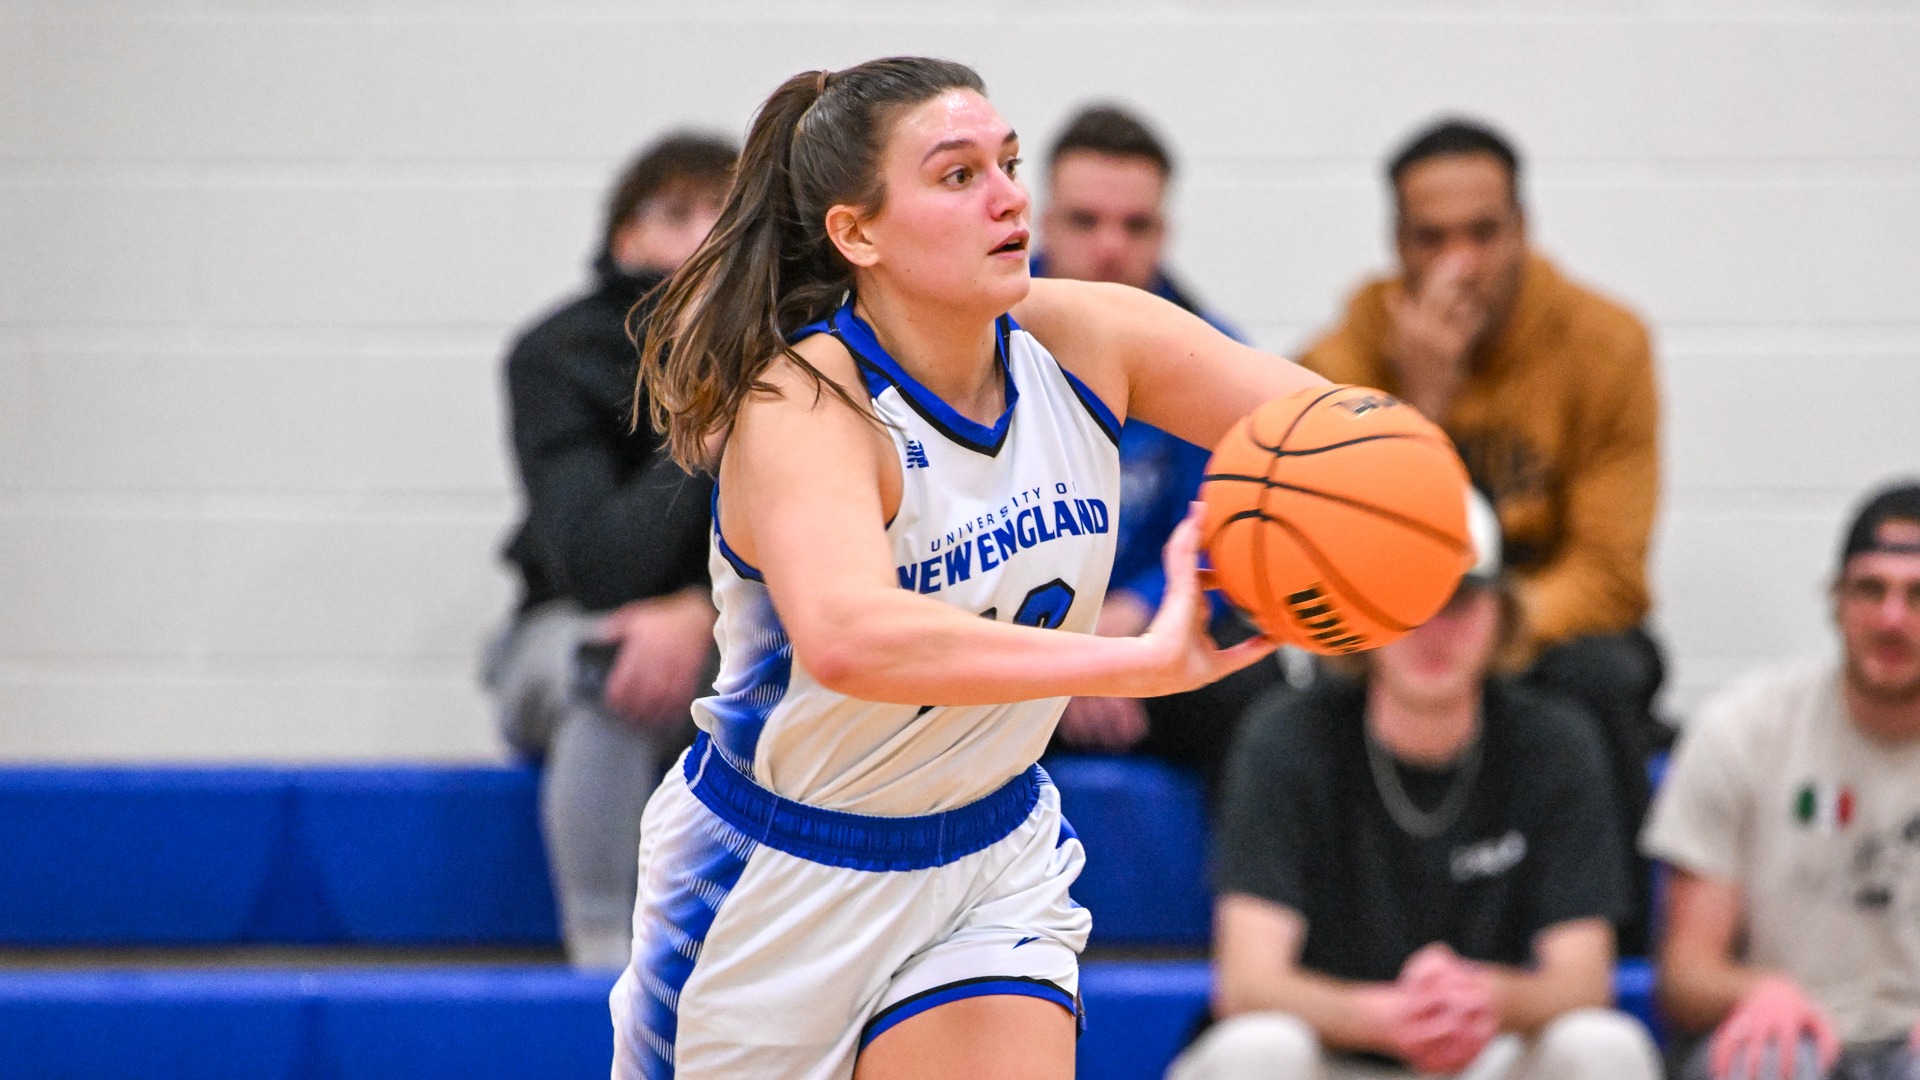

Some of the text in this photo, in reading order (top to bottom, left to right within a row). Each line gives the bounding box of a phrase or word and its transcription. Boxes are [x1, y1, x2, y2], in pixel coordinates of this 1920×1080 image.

[896, 498, 1109, 594] NEW ENGLAND
[930, 487, 1041, 552] UNIVERSITY
[1055, 481, 1076, 495] O
